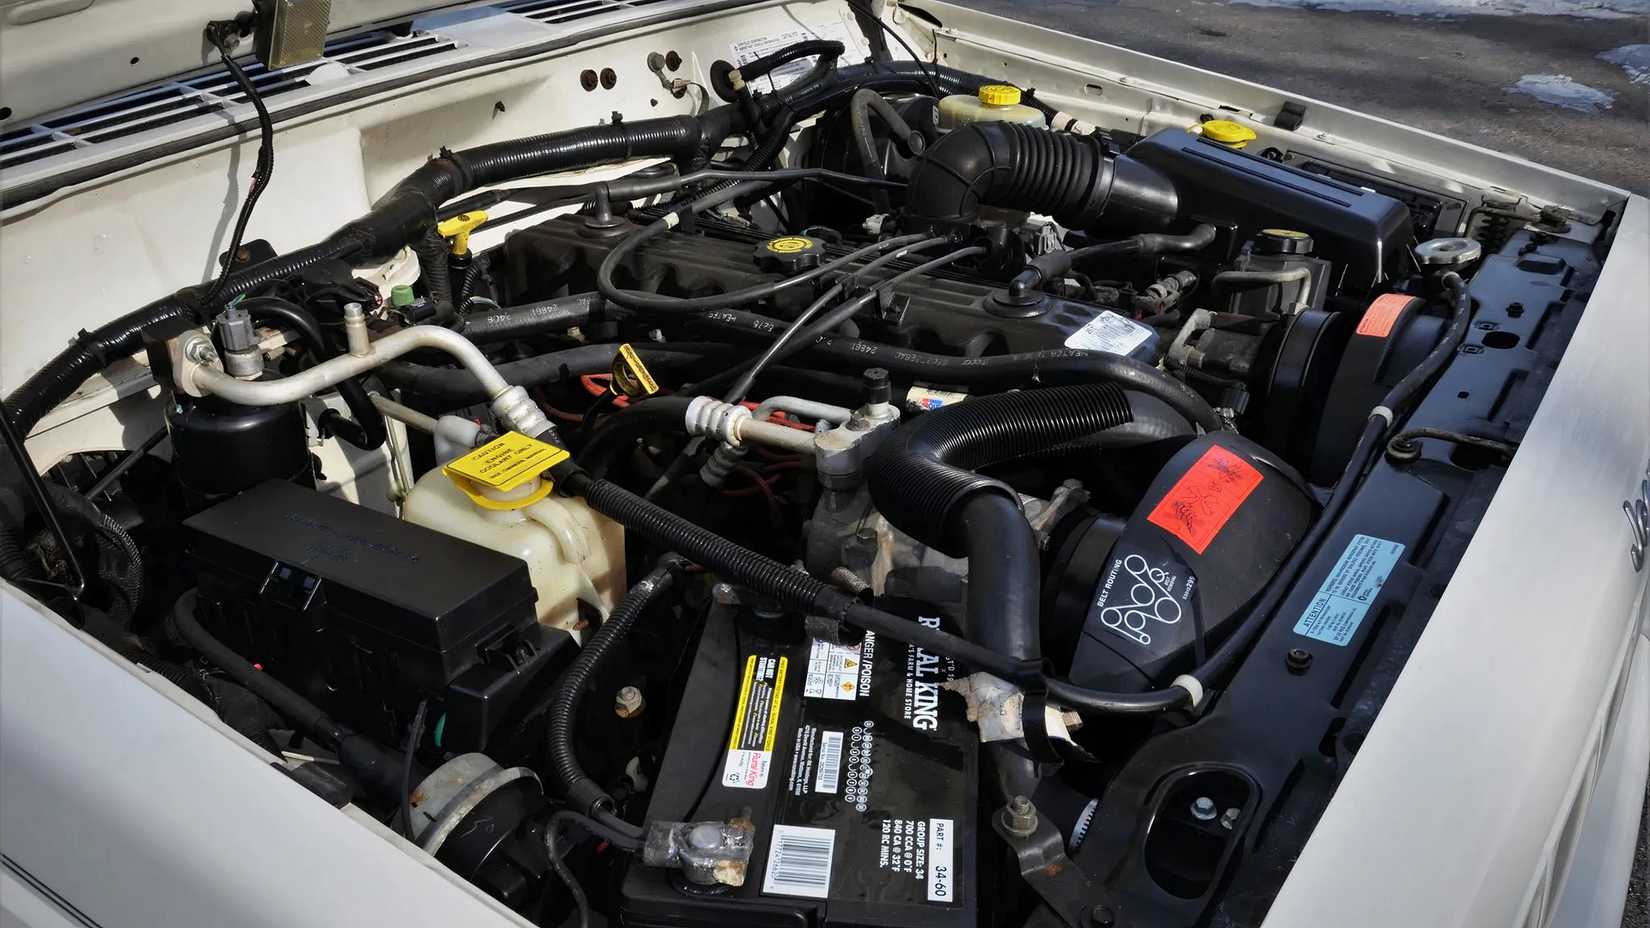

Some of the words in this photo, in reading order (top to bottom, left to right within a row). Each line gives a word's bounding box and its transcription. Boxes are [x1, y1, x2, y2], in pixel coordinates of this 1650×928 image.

[473, 443, 504, 460] CAUTION
[480, 455, 512, 474] COOLANT
[1097, 590, 1110, 608] BELT
[1106, 559, 1122, 590] ROUTING
[1304, 598, 1326, 628] ATTENTION
[916, 616, 940, 677] RAL
[905, 678, 913, 698] HOME
[904, 699, 912, 720] STORE
[912, 681, 938, 730] KING
[750, 752, 761, 770] Rural
[745, 769, 757, 785] King
[882, 820, 891, 834] 120
[894, 820, 902, 834] 840
[906, 820, 914, 834] 700
[916, 821, 926, 848] GROUP
[936, 823, 944, 841] PART
[882, 834, 890, 844] RC
[893, 836, 902, 846] CA
[905, 836, 913, 851] CCA
[880, 845, 890, 868] MINS.
[916, 848, 924, 867] SIZE:
[916, 868, 924, 880] 34
[935, 866, 947, 896] 34-60
